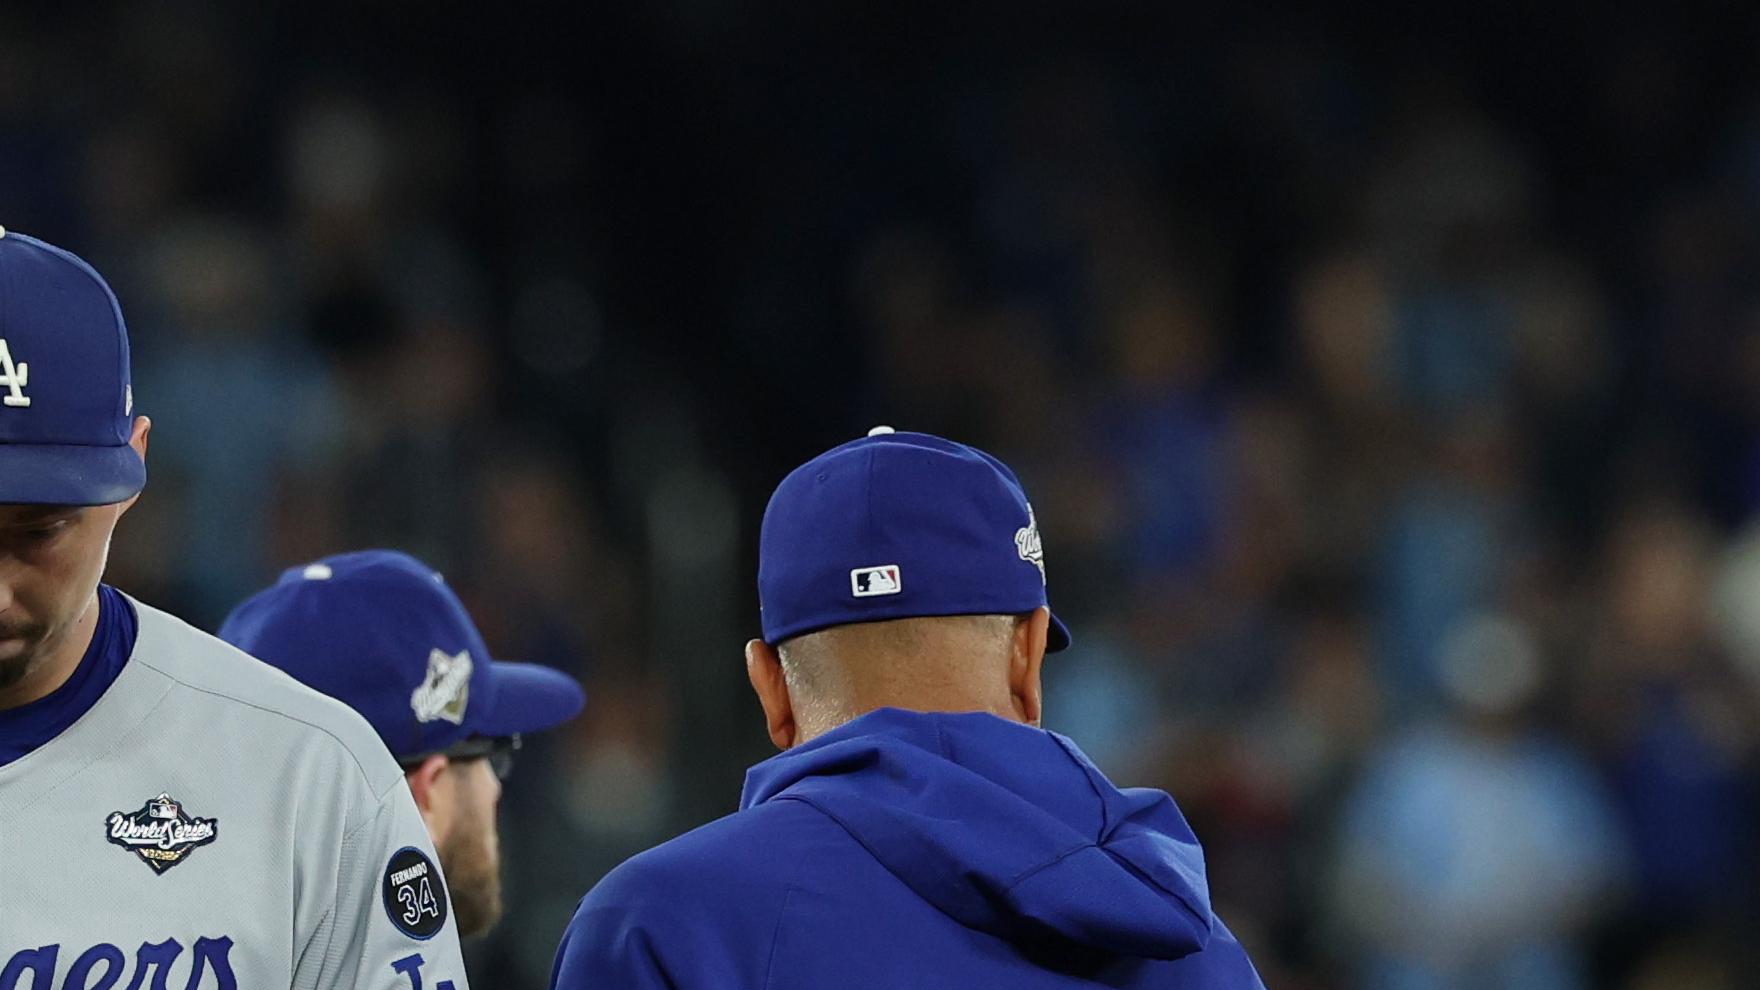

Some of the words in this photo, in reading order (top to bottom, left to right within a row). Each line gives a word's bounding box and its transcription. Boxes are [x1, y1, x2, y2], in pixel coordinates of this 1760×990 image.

[109, 814, 169, 840] World
[158, 819, 214, 849] Series
[390, 861, 428, 886] FERNANDO
[397, 876, 439, 926] 34
